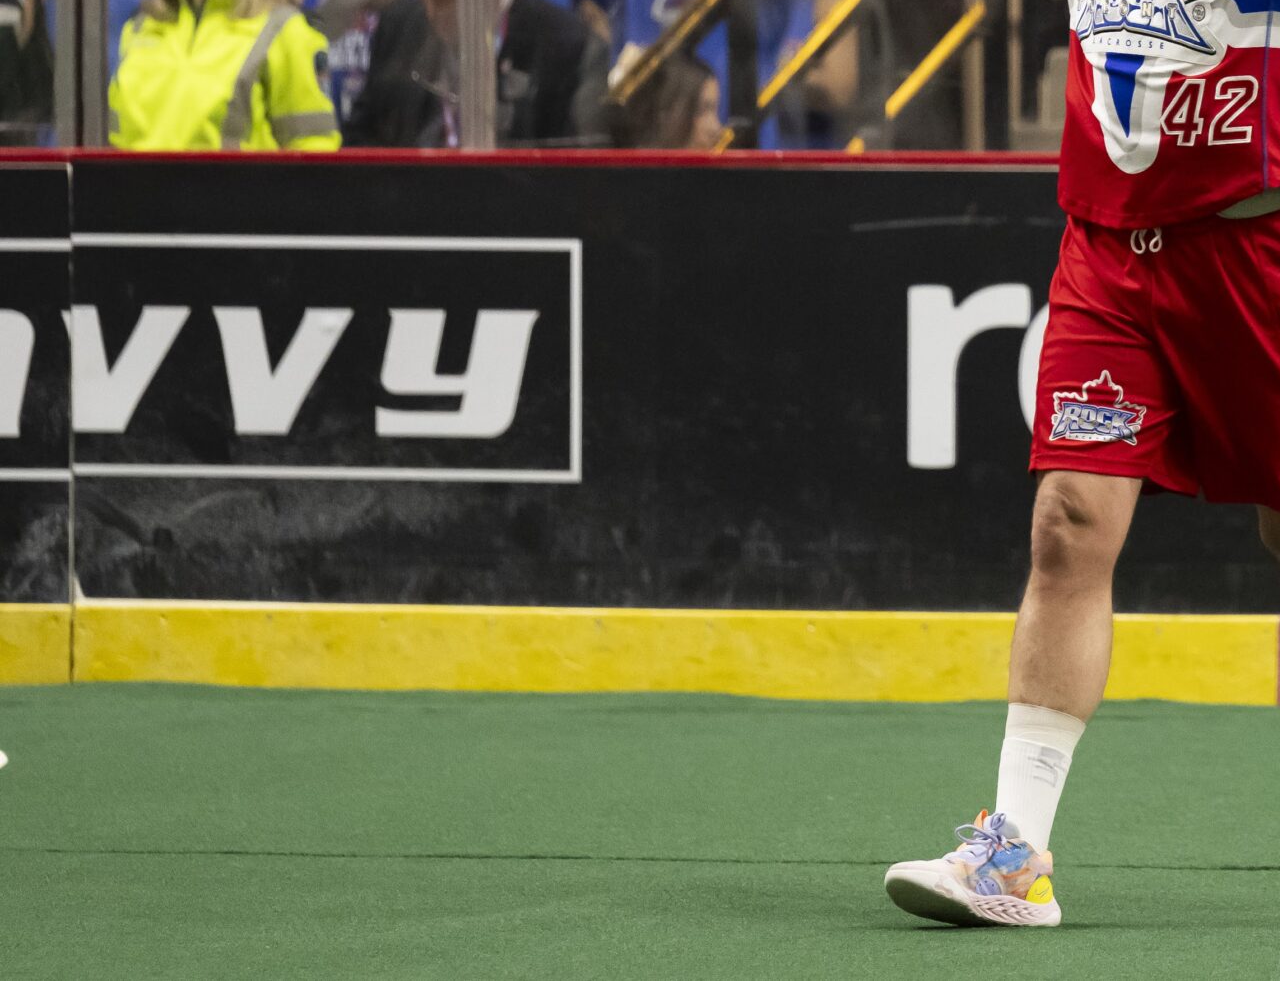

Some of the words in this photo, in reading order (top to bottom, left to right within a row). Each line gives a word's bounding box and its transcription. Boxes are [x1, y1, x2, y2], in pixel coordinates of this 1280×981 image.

[1091, 37, 1166, 50] LACROSSE
[1160, 74, 1260, 147] 42
[1054, 405, 1134, 439] ROCK
